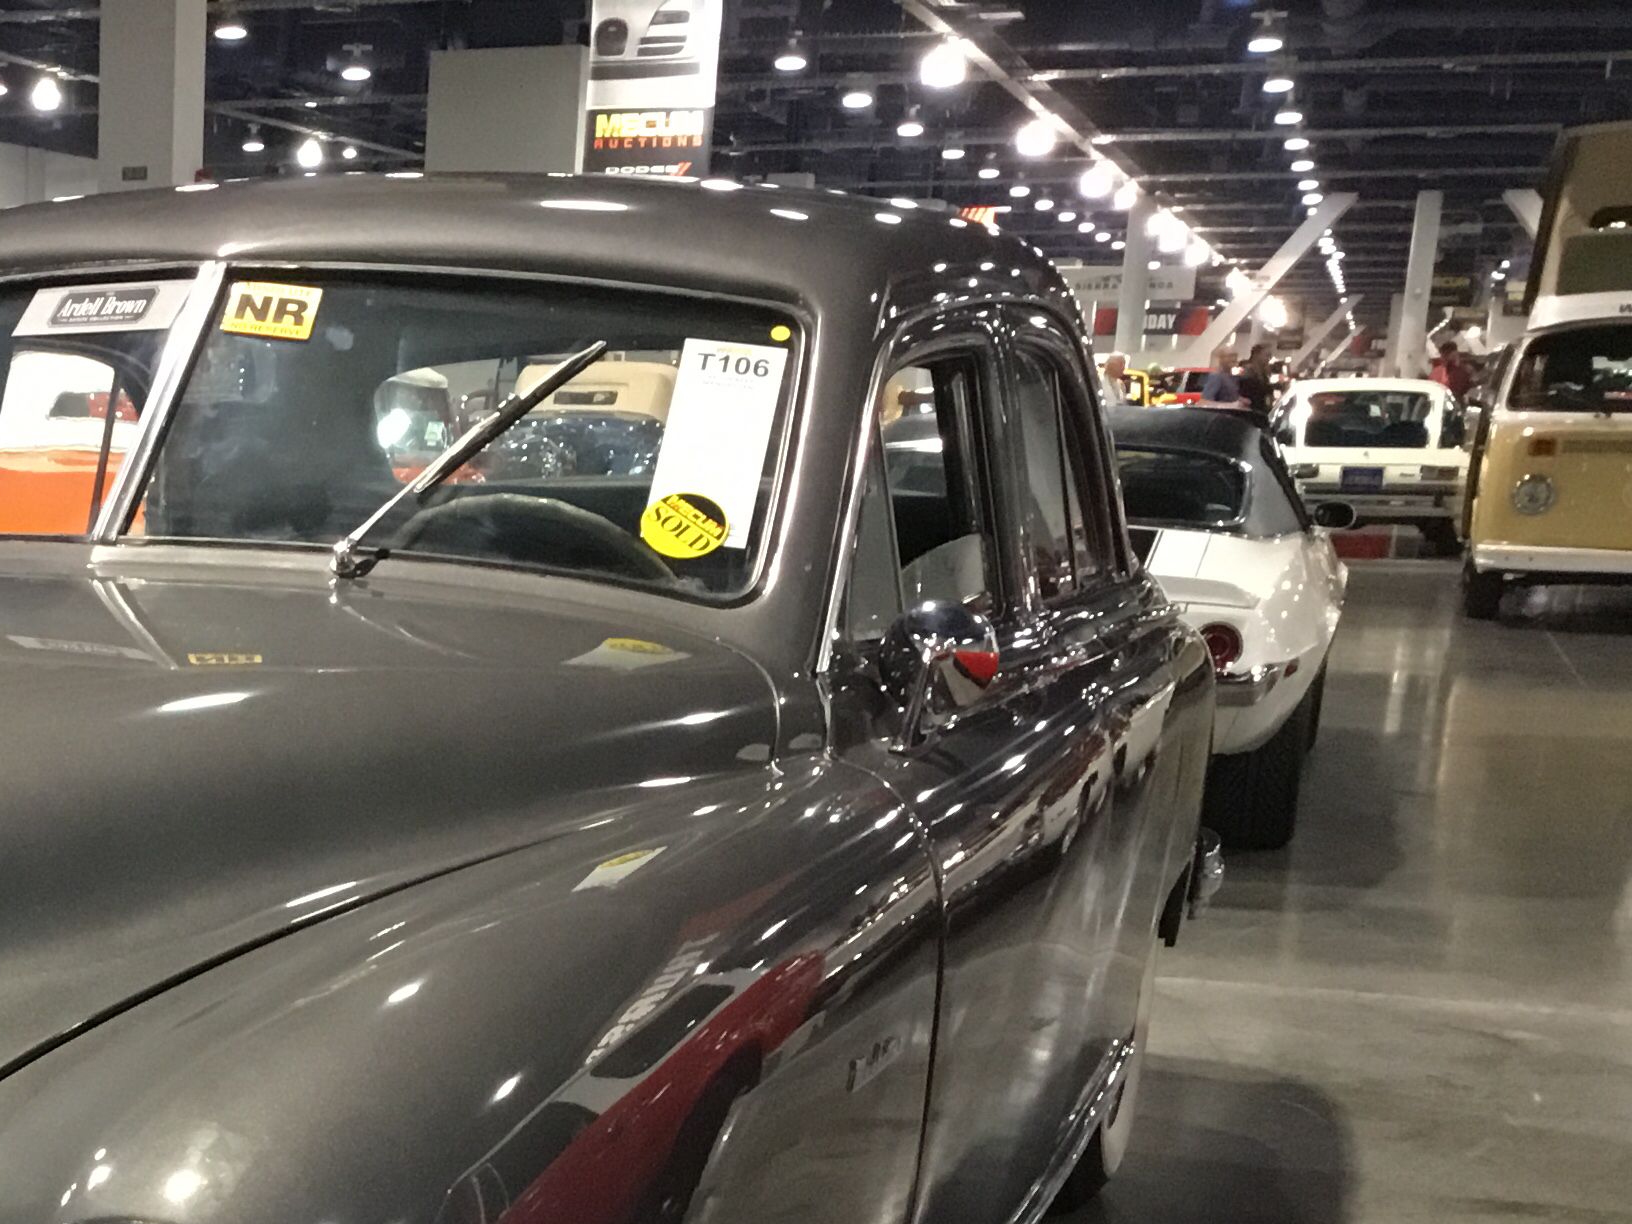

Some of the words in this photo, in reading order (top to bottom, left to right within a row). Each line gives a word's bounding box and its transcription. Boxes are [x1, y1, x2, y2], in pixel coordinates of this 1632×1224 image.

[595, 110, 704, 138] MECUM
[594, 136, 703, 149] AUCTIONS
[57, 297, 104, 317] Ardell
[101, 296, 147, 315] Brown
[234, 293, 309, 326] NR
[1143, 313, 1177, 330] DAY
[698, 352, 770, 377] T106
[647, 506, 711, 551] SOLD
